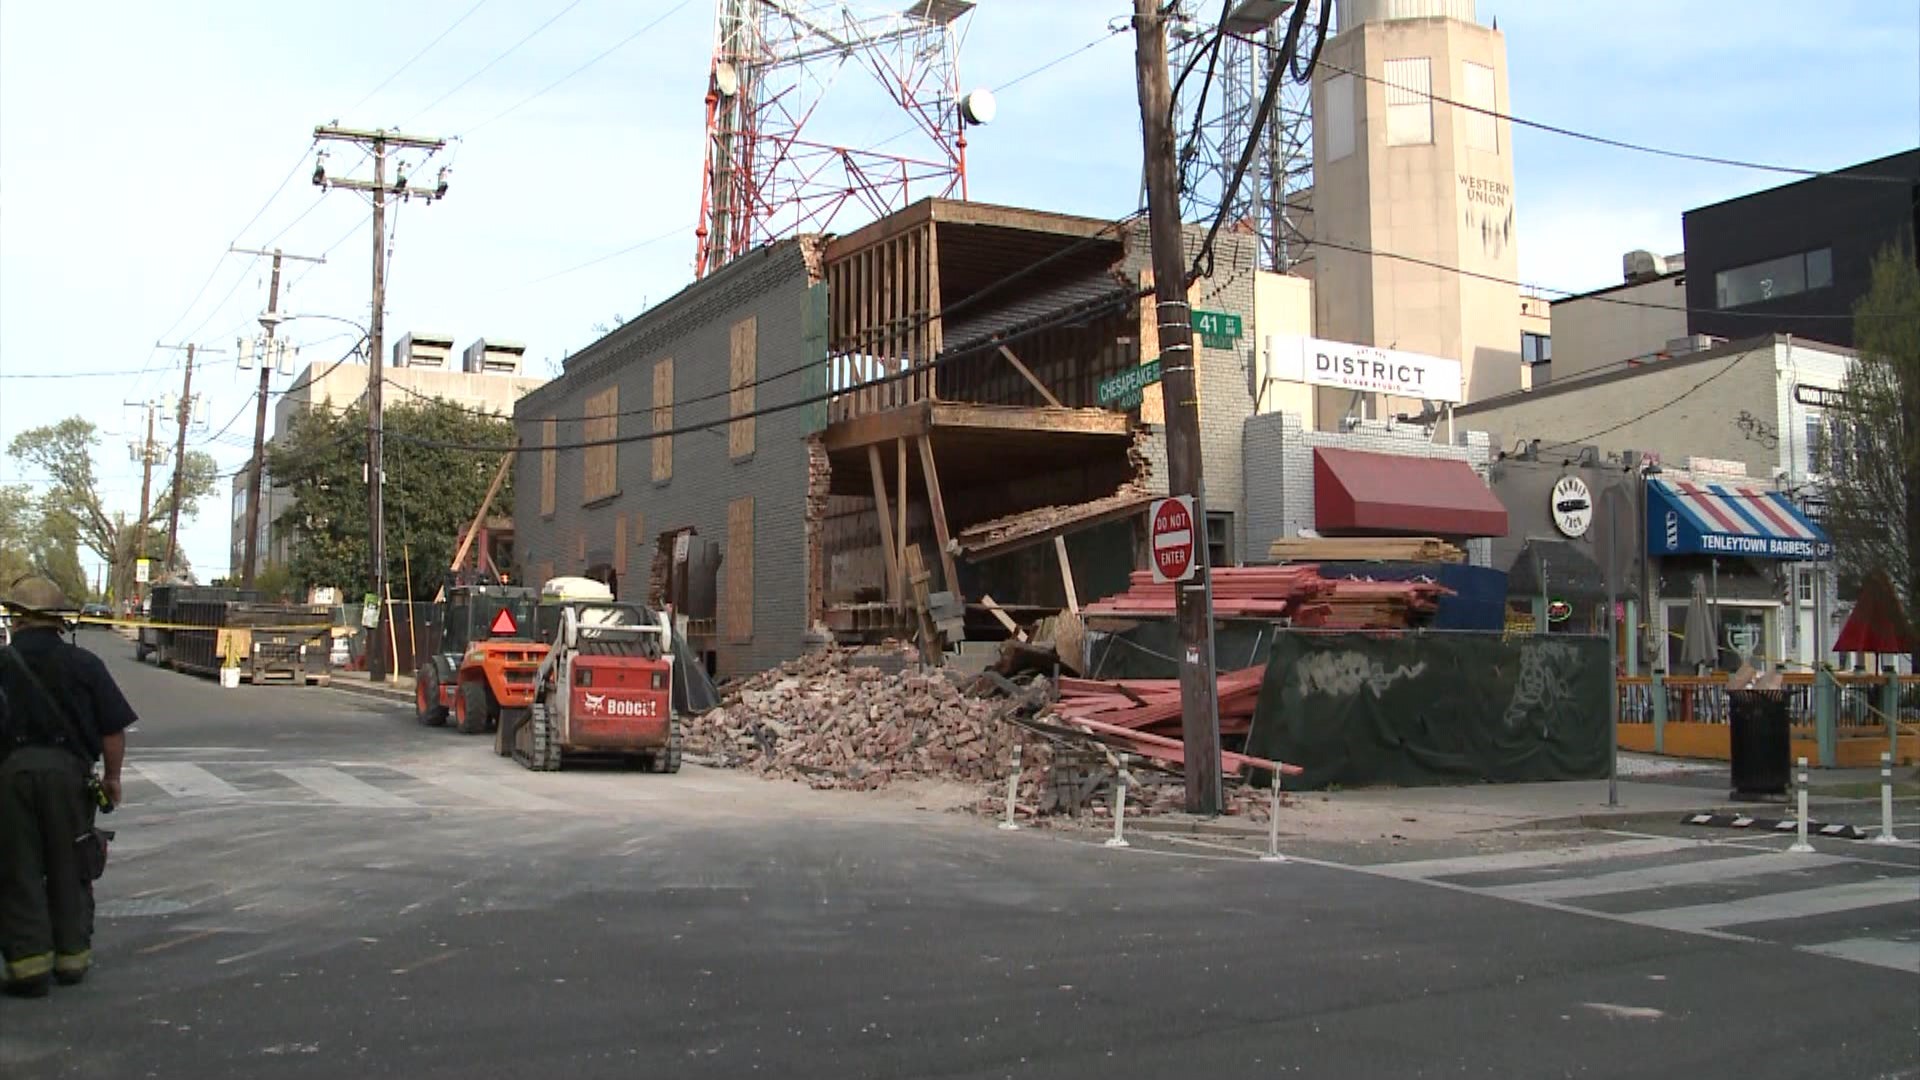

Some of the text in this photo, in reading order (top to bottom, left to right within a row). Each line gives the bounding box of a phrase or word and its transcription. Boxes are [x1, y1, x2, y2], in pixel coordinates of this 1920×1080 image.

[1459, 174, 1509, 195] WESTERN
[1467, 189, 1504, 206] UNION
[1200, 314, 1217, 333] 41
[1316, 353, 1425, 384] DISTRICT
[1100, 365, 1152, 402] CHESAPEAKE
[1157, 513, 1186, 530] DO NOT
[1701, 535, 1831, 556] TENLEYTOWN BARBERSOP
[1161, 549, 1185, 566] ENTER
